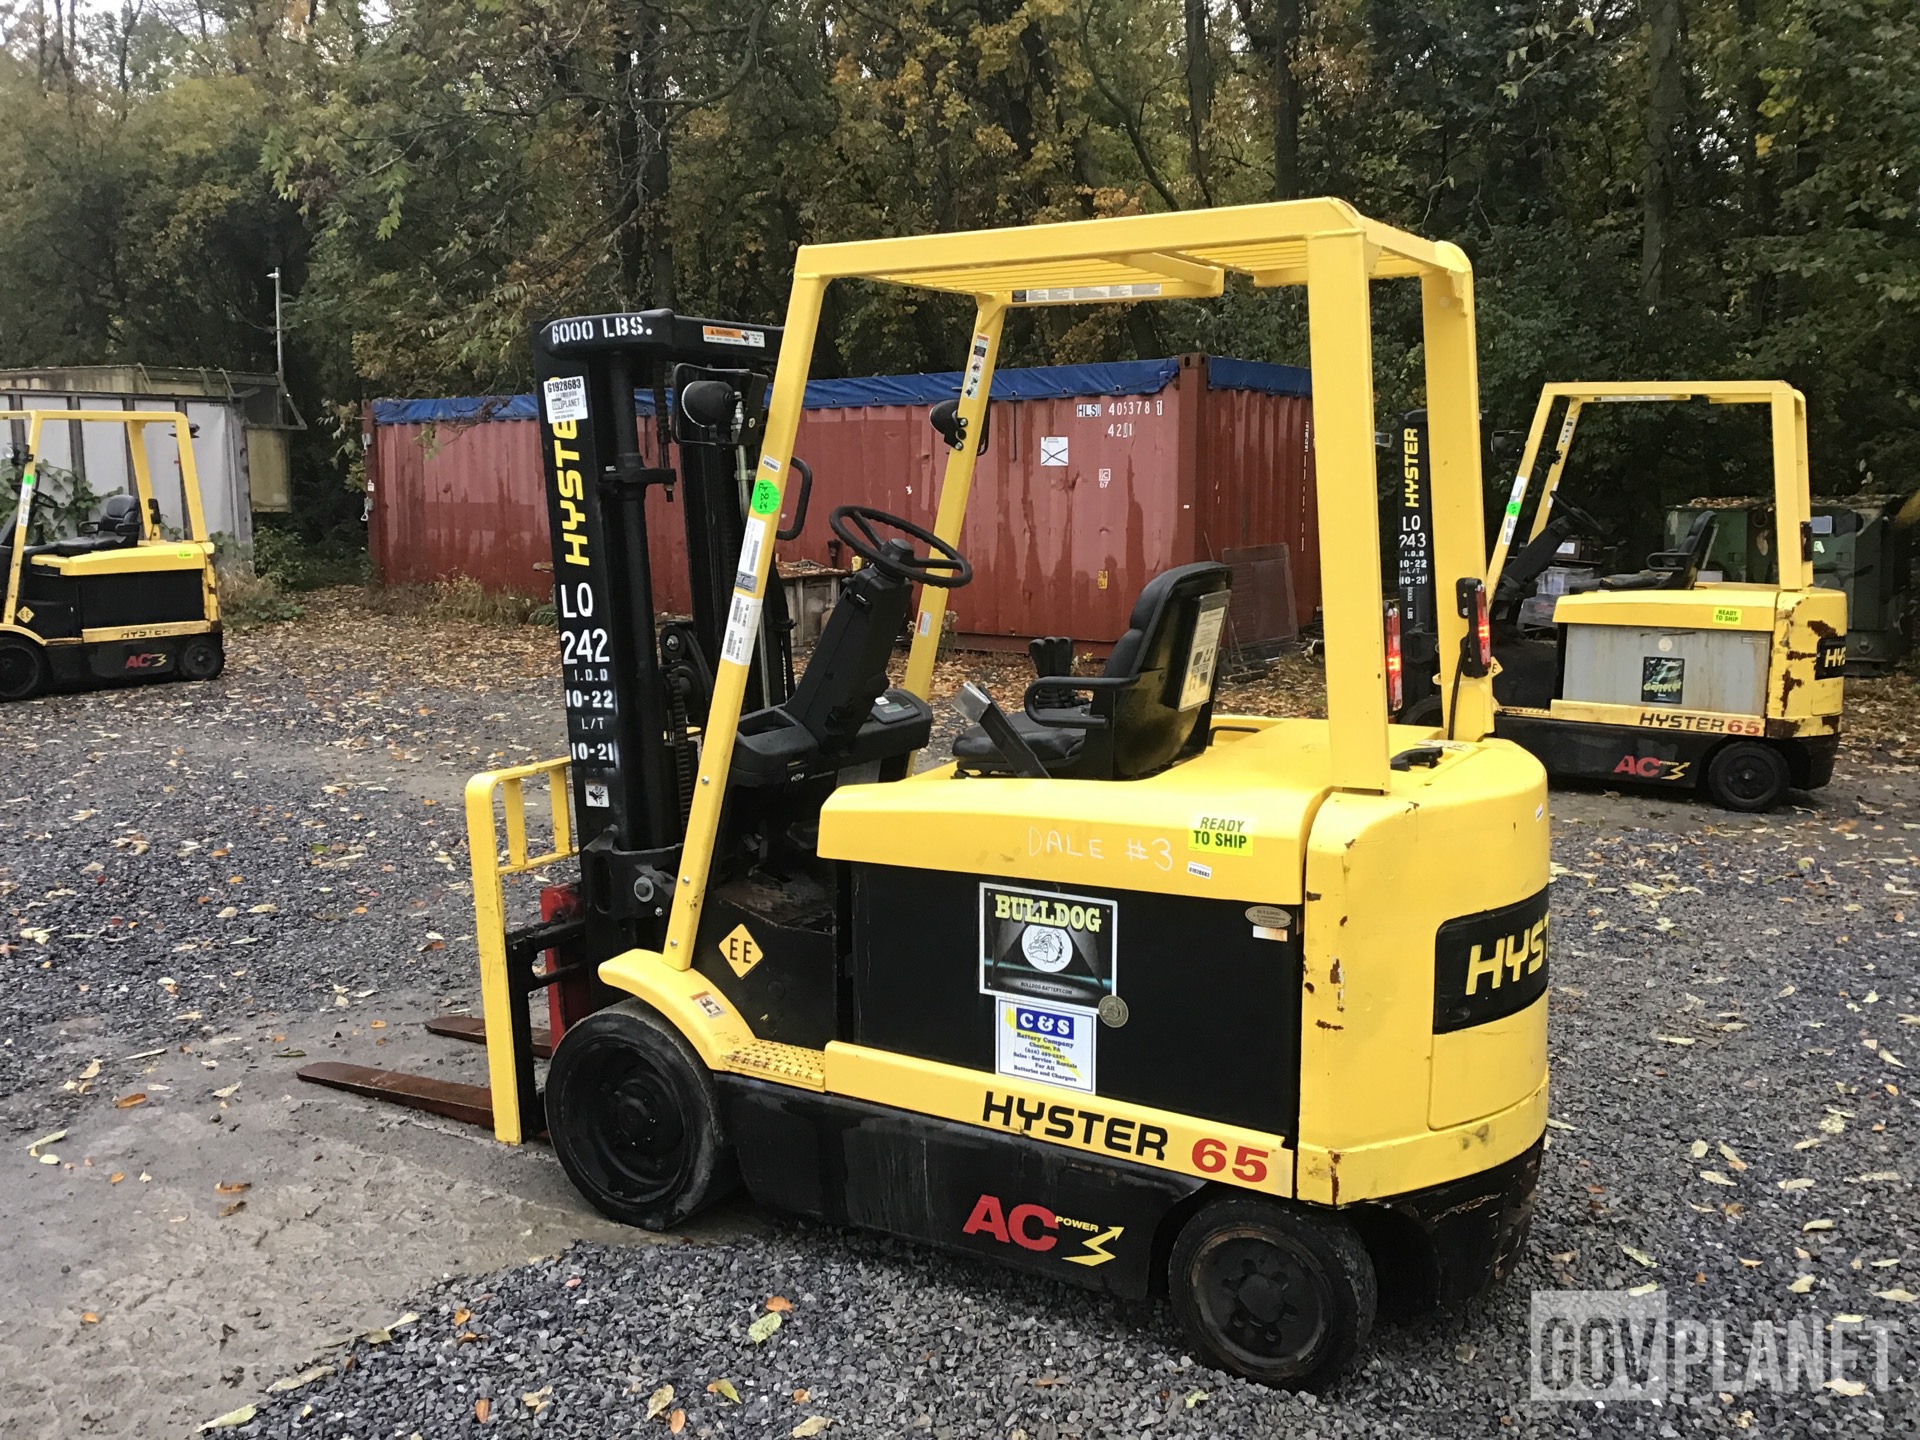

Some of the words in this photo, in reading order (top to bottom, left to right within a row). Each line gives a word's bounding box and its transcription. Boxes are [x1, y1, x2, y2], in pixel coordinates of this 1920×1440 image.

[552, 320, 594, 344] 6000
[602, 316, 653, 338] LBS.
[1108, 400, 1150, 415] 405378
[1403, 427, 1419, 508] HYSTER
[550, 419, 591, 566] HYSTE
[1400, 559, 1427, 568] 10-22
[560, 628, 610, 665] 242
[566, 690, 614, 708] 10-22
[581, 717, 604, 730] L/T
[1639, 712, 1725, 732] HYSTER
[1727, 719, 1761, 735] 65
[571, 742, 614, 761] 10-21
[1613, 755, 1661, 777] AC
[1200, 816, 1245, 832] READY
[1028, 825, 1105, 860] DALE
[1193, 830, 1210, 845] TO
[1215, 832, 1247, 848] SHIP
[995, 894, 1102, 932] BULLDOG
[1016, 1032, 1041, 1043] Battery
[1043, 1036, 1074, 1049] Company
[1013, 1051, 1027, 1060] Sales
[1056, 1060, 1078, 1069] Rentals
[1014, 1065, 1039, 1074] Batteries
[1040, 1069, 1050, 1077] and
[982, 1091, 1169, 1161] HYSTER
[1191, 1138, 1269, 1183] 65
[962, 1194, 1060, 1252] AC
[1054, 1215, 1099, 1233] POWER
